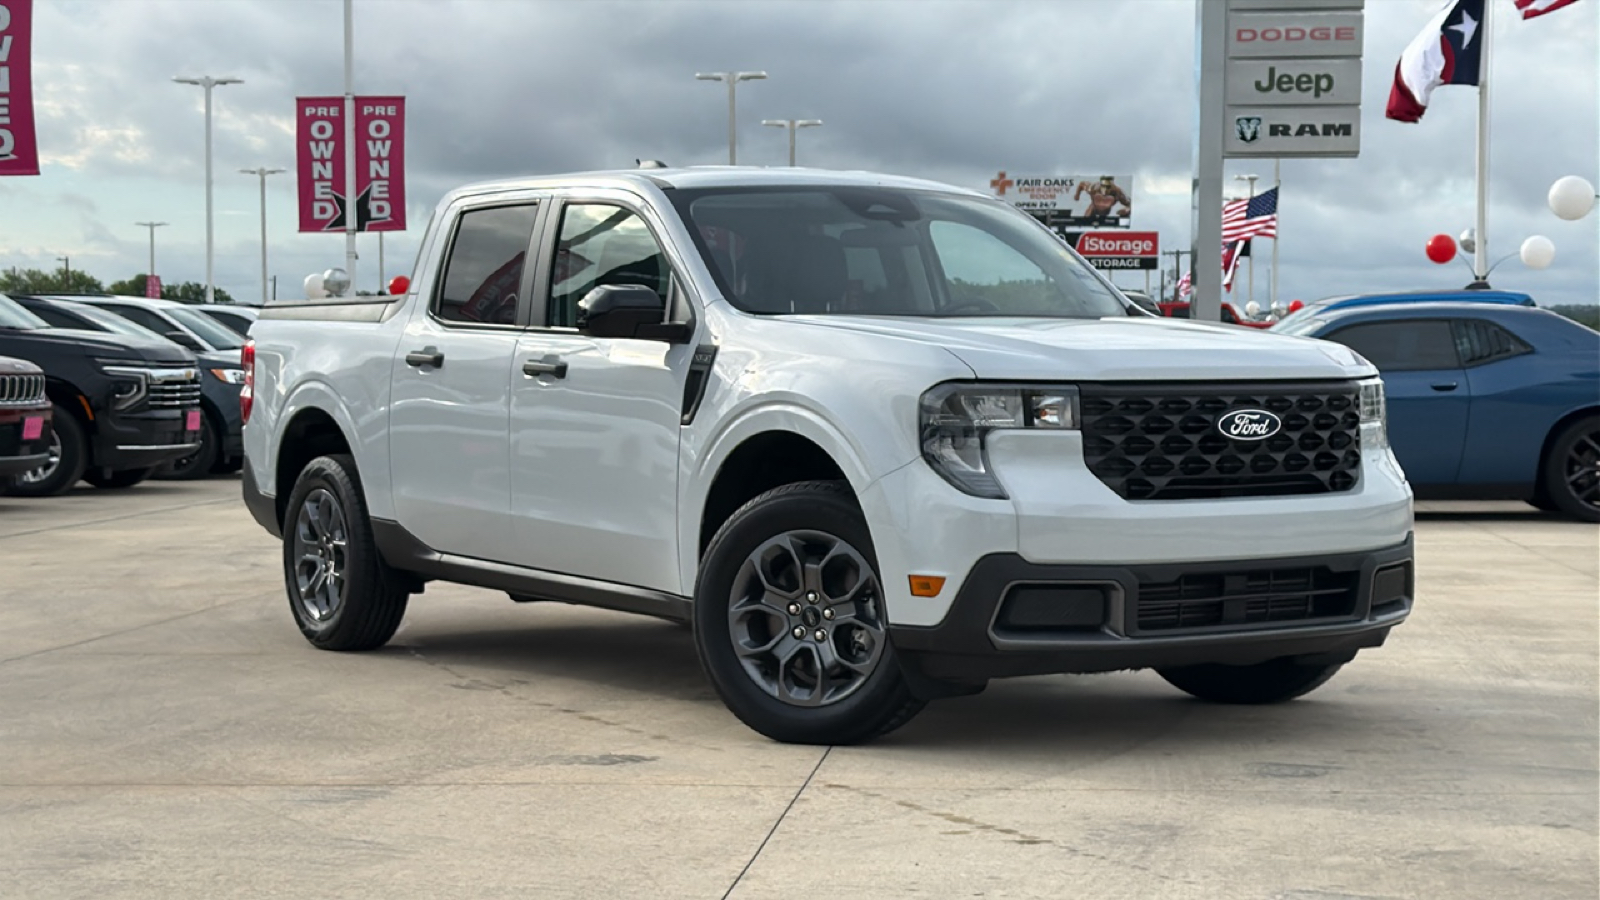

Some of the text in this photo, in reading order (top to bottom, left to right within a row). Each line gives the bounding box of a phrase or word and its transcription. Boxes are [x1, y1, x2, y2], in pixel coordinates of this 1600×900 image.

[1236, 27, 1355, 42] DODGE
[1254, 66, 1335, 98] Jeep
[305, 106, 340, 117] PRE
[363, 105, 397, 116] PRE
[1268, 123, 1352, 137] RAM
[309, 120, 335, 220] OWNED
[366, 119, 392, 219] OWNED
[1016, 178, 1075, 187] FAIR OAKS
[1084, 236, 1153, 255] iStorage
[1092, 259, 1141, 267] STORAGE
[1230, 414, 1270, 435] Ford
